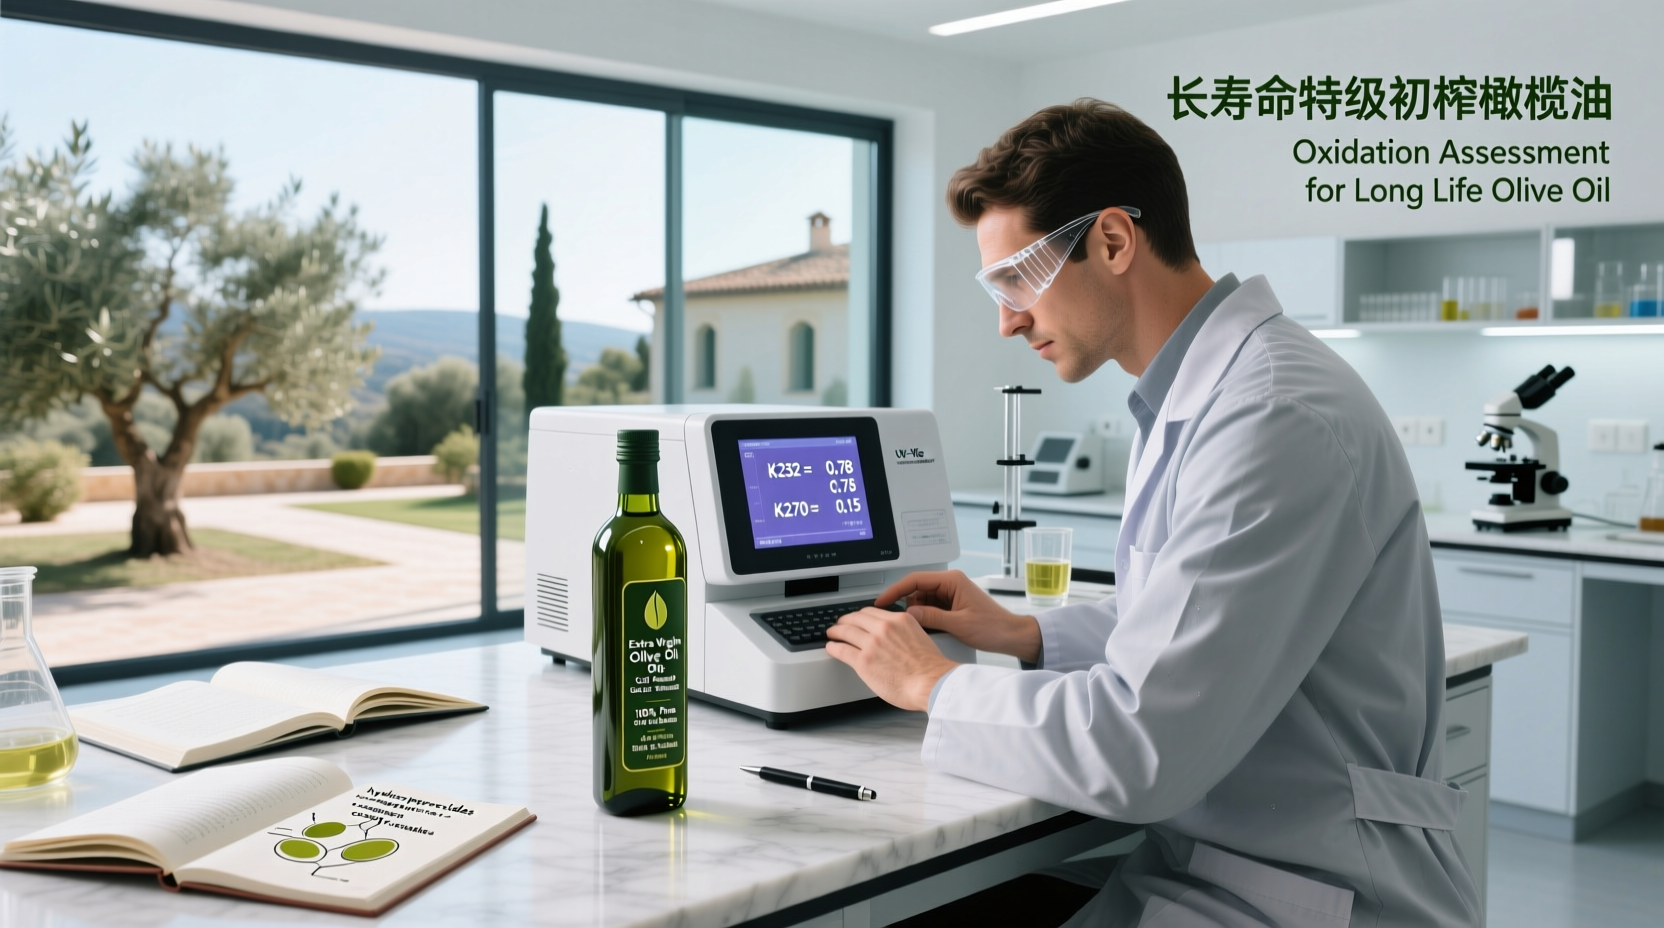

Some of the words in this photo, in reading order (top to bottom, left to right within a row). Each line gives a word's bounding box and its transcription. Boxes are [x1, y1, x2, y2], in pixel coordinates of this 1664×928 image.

[835, 497, 862, 514] 0.15
[629, 649, 661, 663] Olive
[665, 647, 679, 660] Oil
